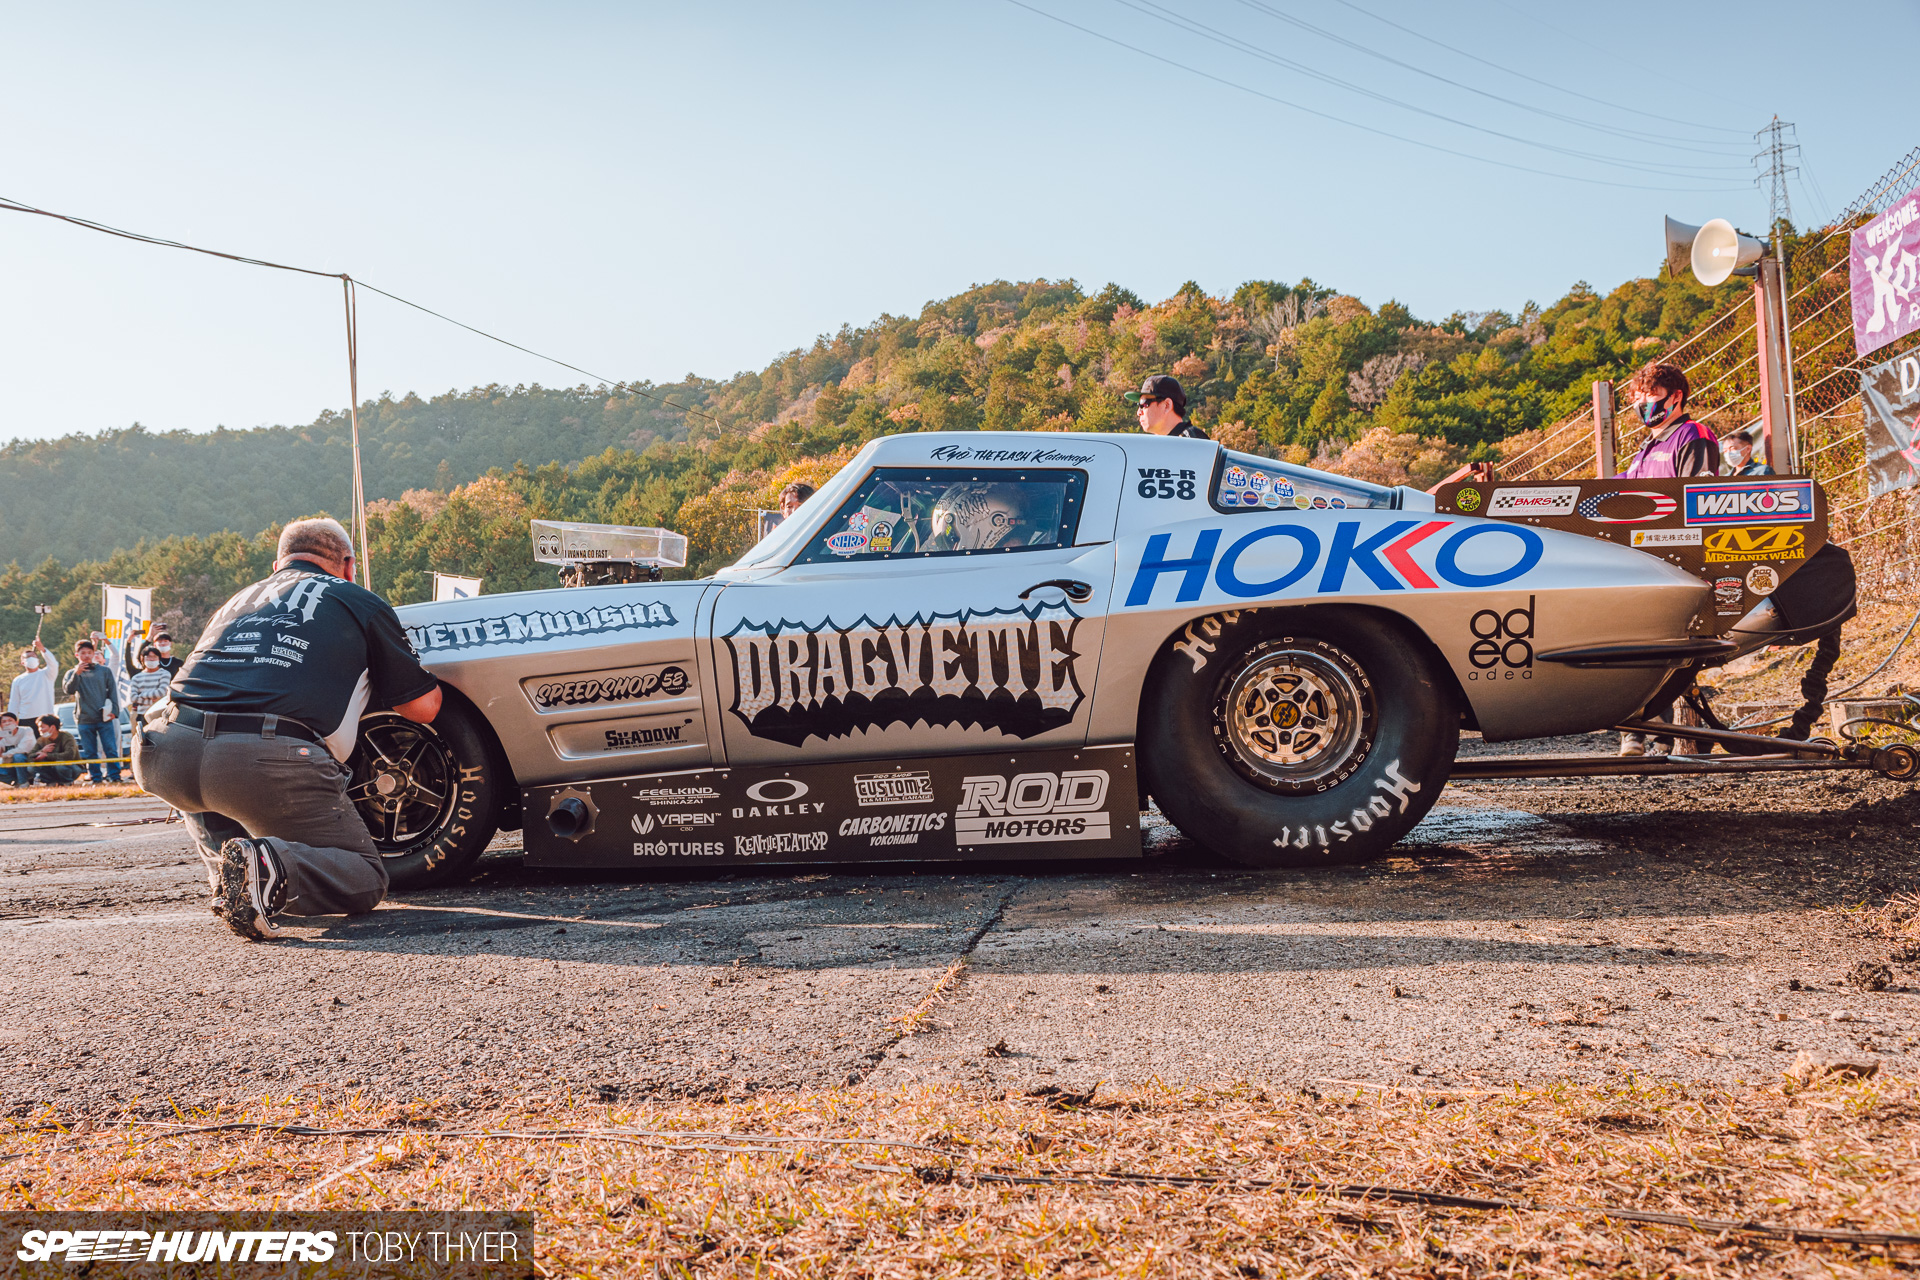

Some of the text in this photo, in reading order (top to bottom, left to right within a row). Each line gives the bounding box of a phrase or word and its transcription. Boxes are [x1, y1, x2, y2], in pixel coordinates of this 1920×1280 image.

[1866, 198, 1919, 249] WELCOME
[930, 444, 973, 462] Ryo
[1137, 468, 1196, 480] V8-R
[1137, 480, 1196, 500] 658
[1514, 497, 1552, 506] BMRS
[1697, 490, 1801, 516] WAKO'S
[833, 535, 863, 547] NHRA
[567, 550, 587, 558] WANNA
[595, 550, 608, 558] FAST
[1705, 549, 1805, 563] MECHANIX WEAR
[276, 571, 348, 584] RACING
[276, 632, 310, 650] VANS
[724, 601, 1084, 726] DRAGVETTE
[1244, 636, 1370, 689] WELD RACING
[1468, 668, 1533, 681] adea
[536, 671, 684, 707] SPEED SHOP 58
[1316, 741, 1371, 792] FORGED
[640, 787, 713, 796] FEELKIND
[955, 769, 1110, 818] ROD
[732, 802, 825, 819] OAKLEY
[1273, 759, 1421, 855] Hoosier
[424, 763, 486, 871] Hoosier
[839, 812, 947, 837] CARBONETICS
[985, 818, 1086, 838] MOTORS
[869, 833, 918, 847] YOKOHAMA
